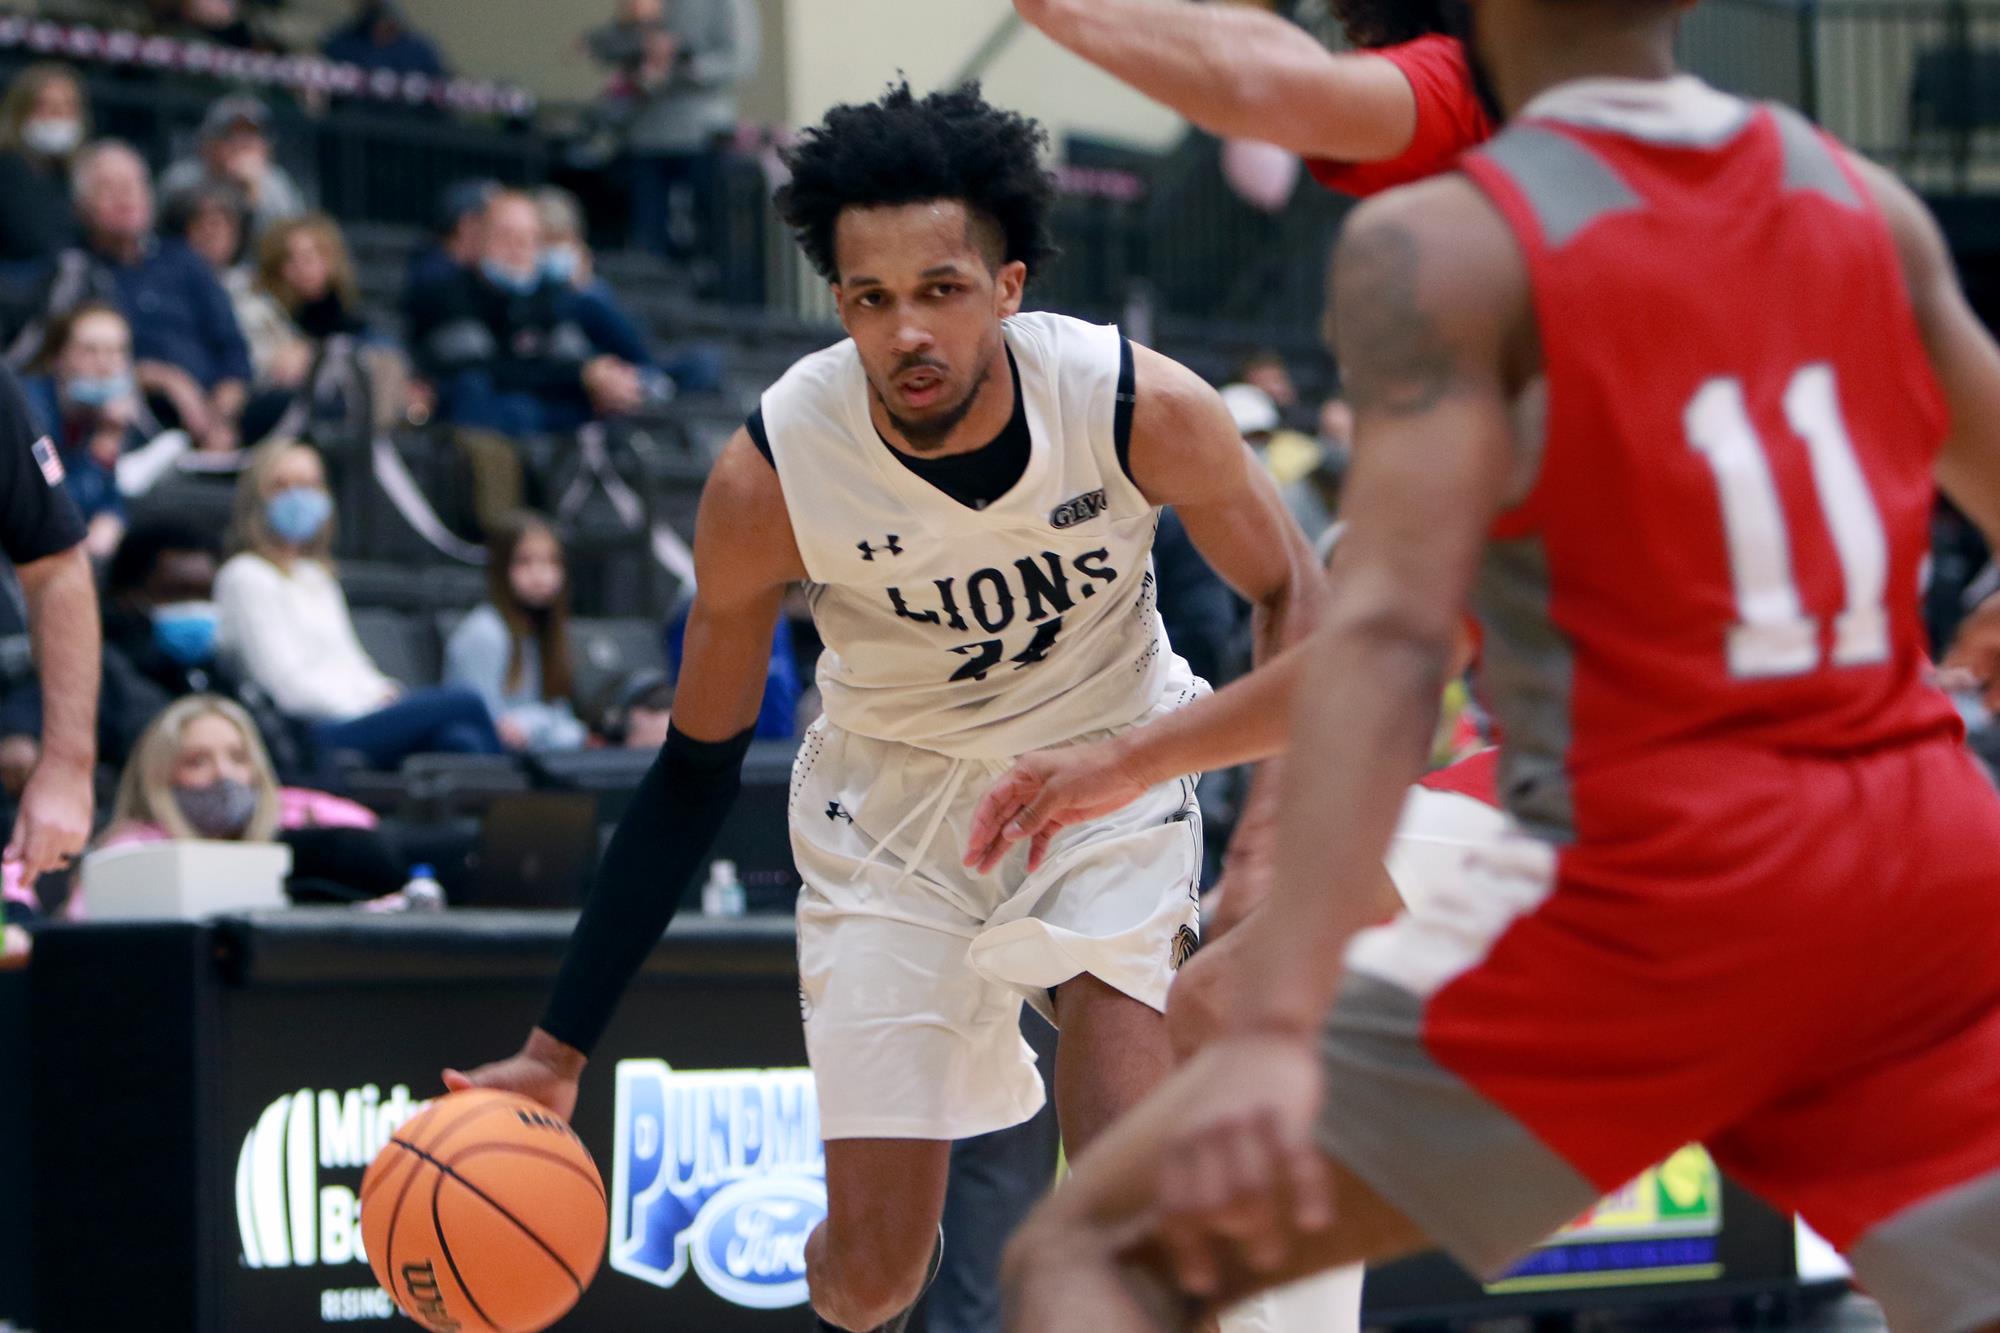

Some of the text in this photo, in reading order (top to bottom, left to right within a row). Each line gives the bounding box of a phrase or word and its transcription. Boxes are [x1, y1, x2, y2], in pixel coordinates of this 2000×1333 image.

[1683, 364, 1889, 680] 11
[886, 548, 1117, 634] LIONS
[319, 1083, 432, 1168] Mid
[621, 1064, 822, 1240] PUNDM
